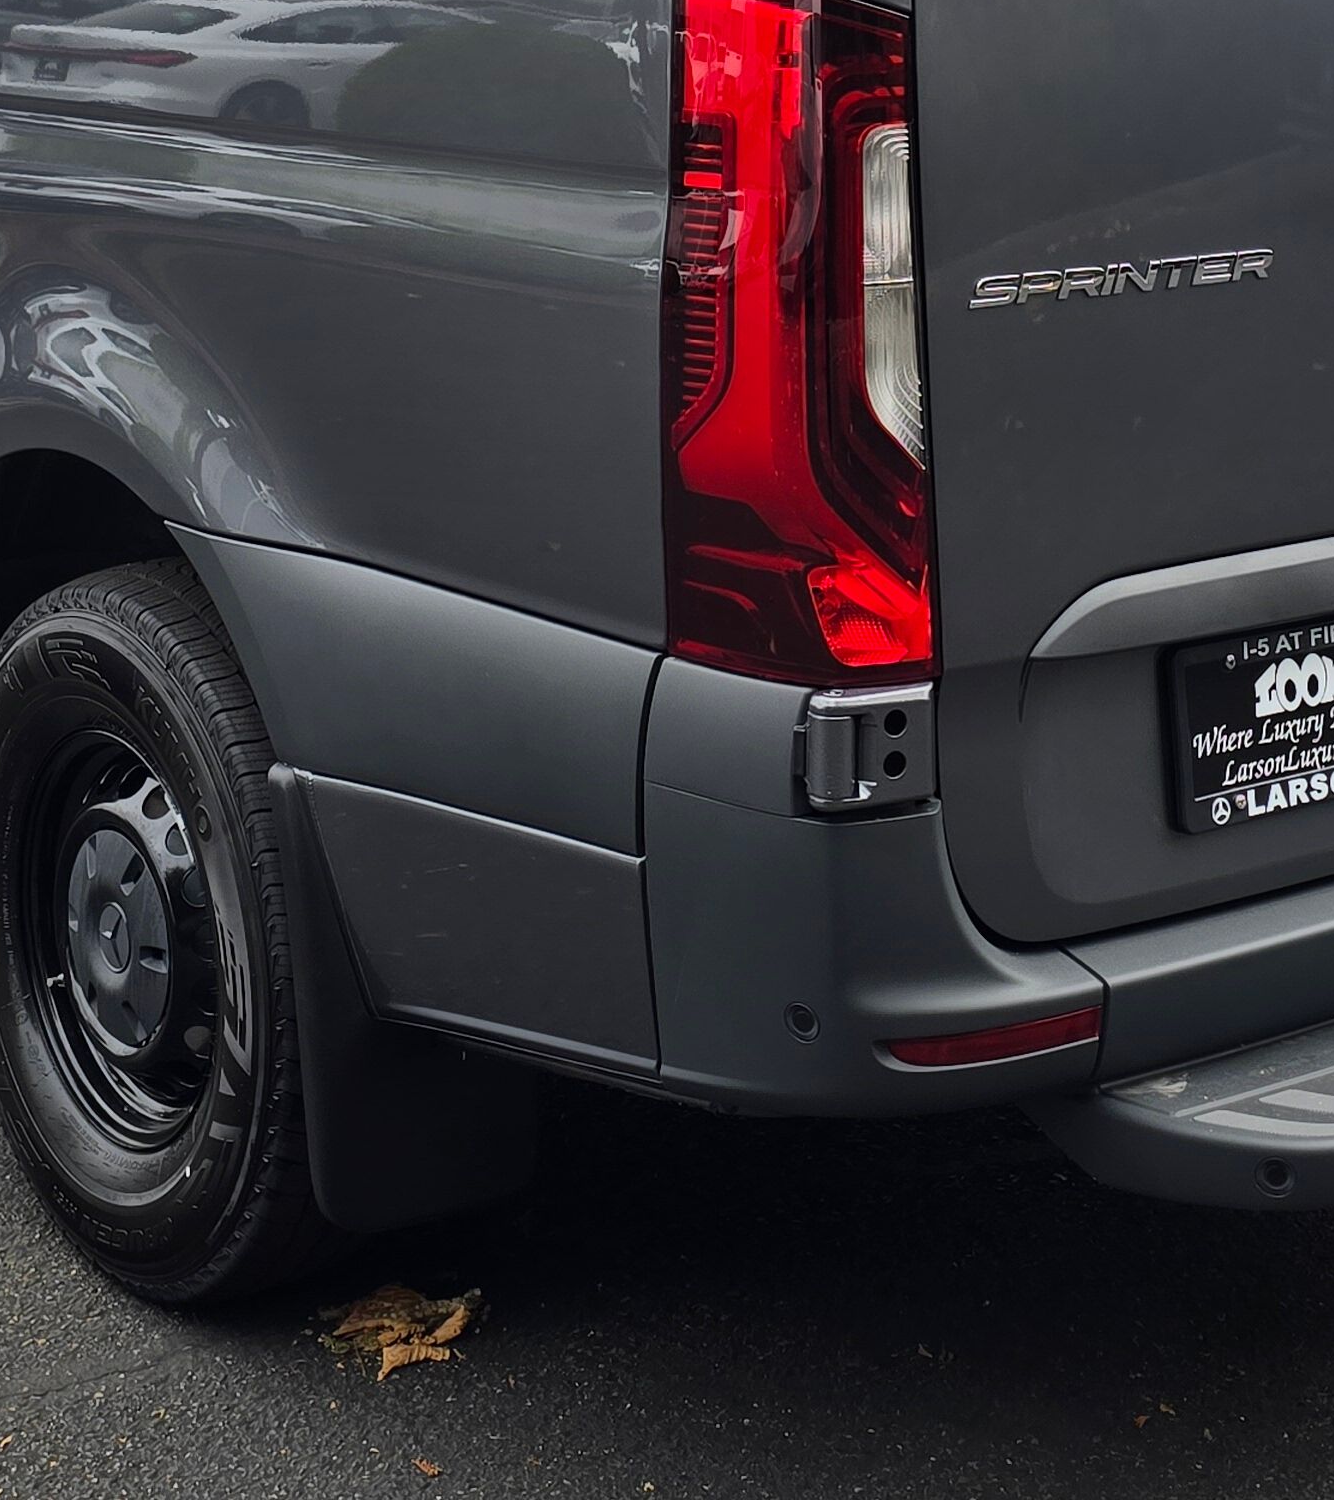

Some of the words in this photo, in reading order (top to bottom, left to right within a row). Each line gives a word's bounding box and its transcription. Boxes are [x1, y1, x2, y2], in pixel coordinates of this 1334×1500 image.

[969, 248, 1274, 310] SPRINTER
[1242, 637, 1270, 661] I-5
[1274, 631, 1304, 654] AT
[1192, 724, 1254, 759] Where
[1258, 713, 1325, 744] Luxury
